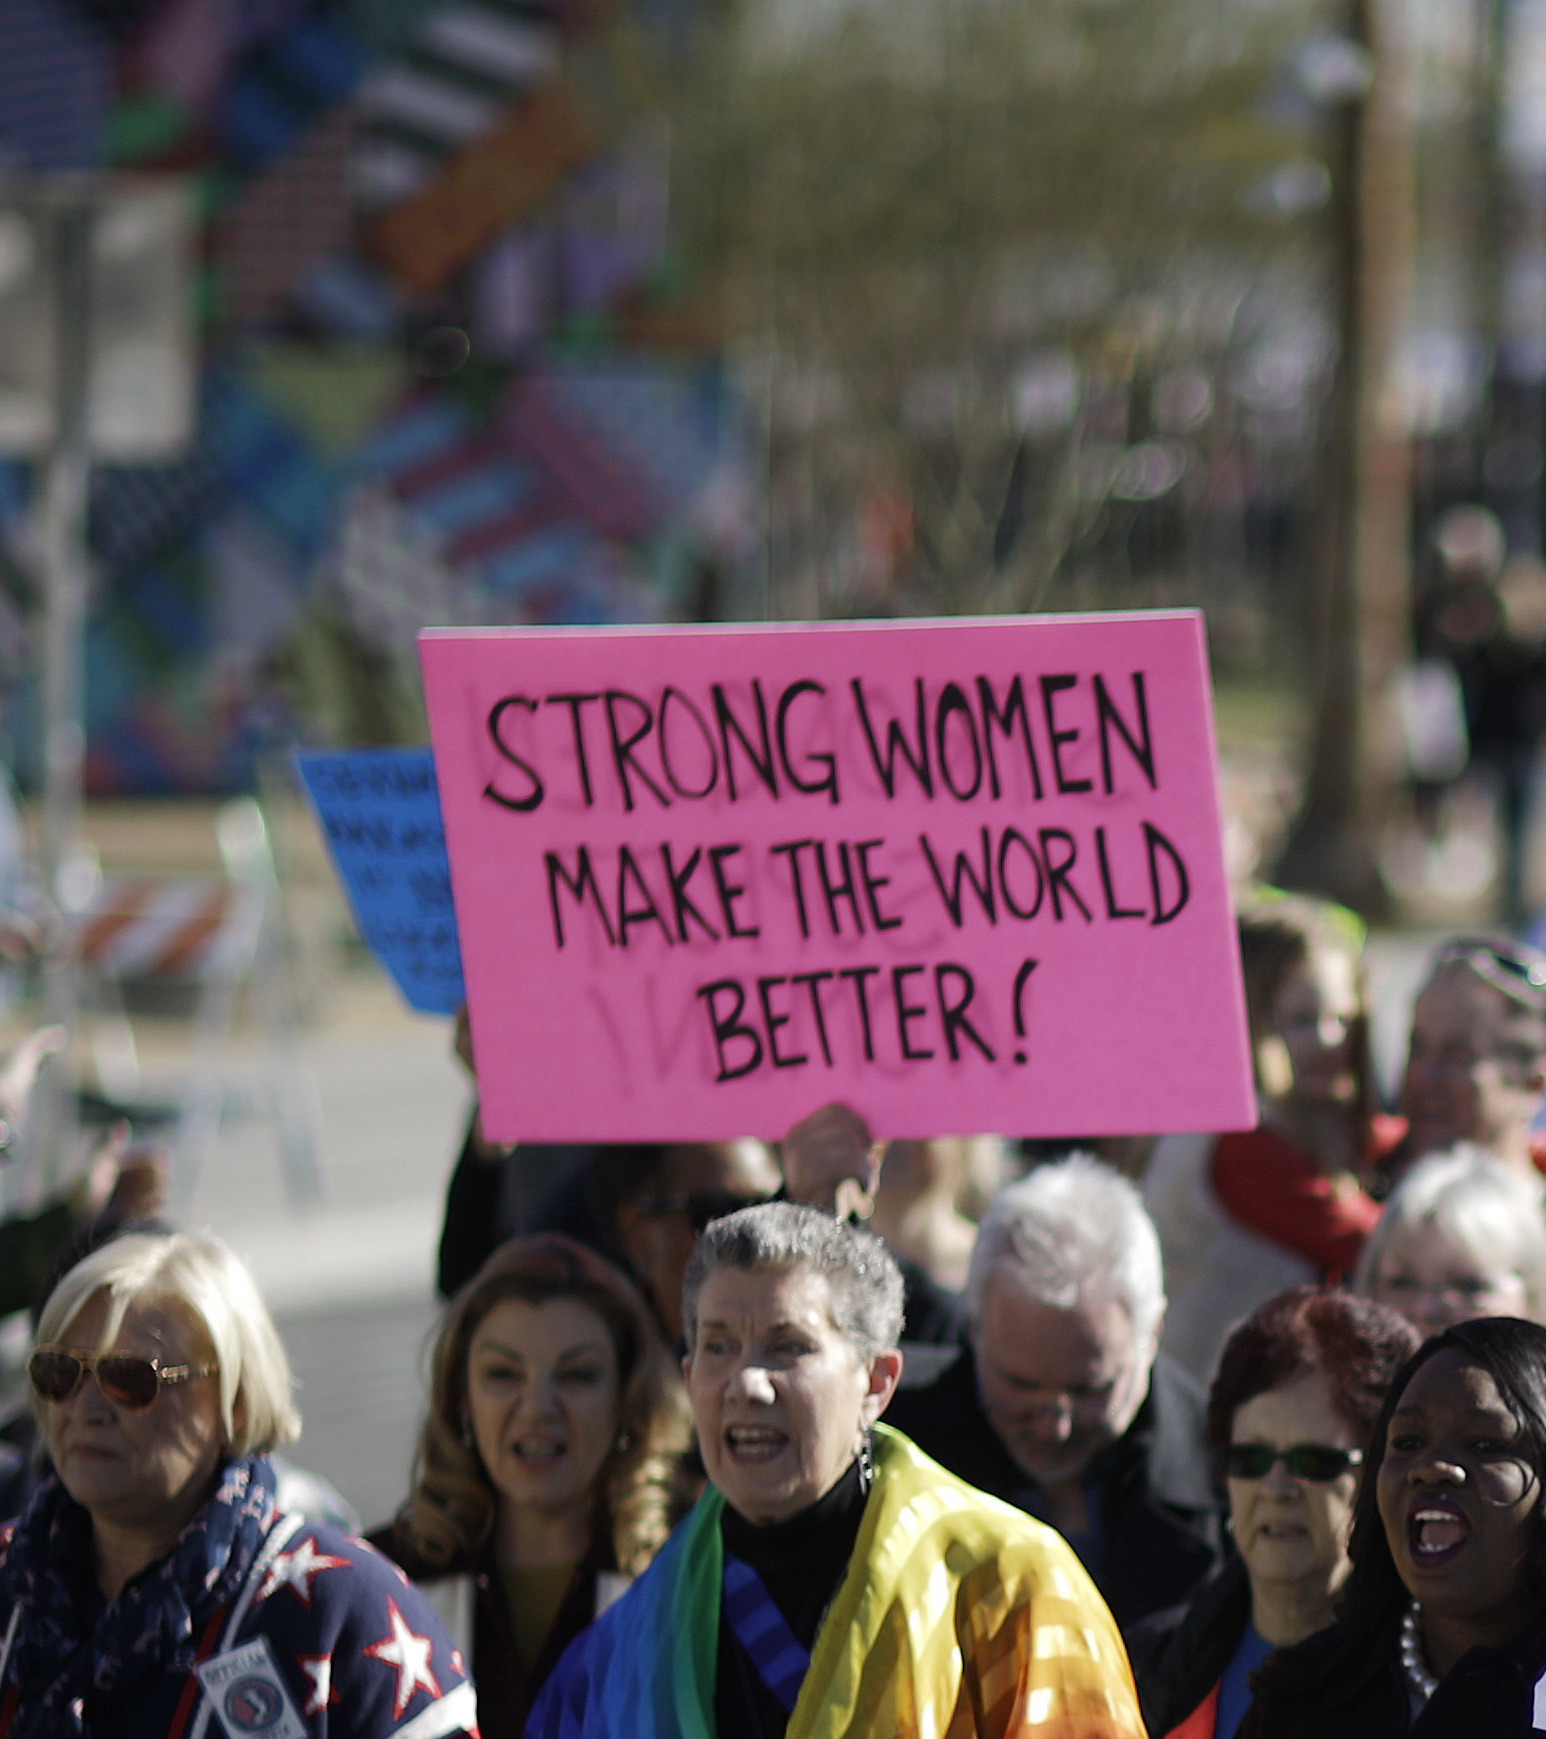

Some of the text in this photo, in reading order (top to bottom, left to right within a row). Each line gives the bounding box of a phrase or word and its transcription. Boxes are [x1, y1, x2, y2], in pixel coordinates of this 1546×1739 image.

[484, 671, 1158, 812] STRONG WOMEN
[544, 841, 760, 950] MAKE
[771, 838, 903, 941] THE
[920, 822, 1191, 928] WORLD
[697, 958, 1040, 1082] BETTER!
